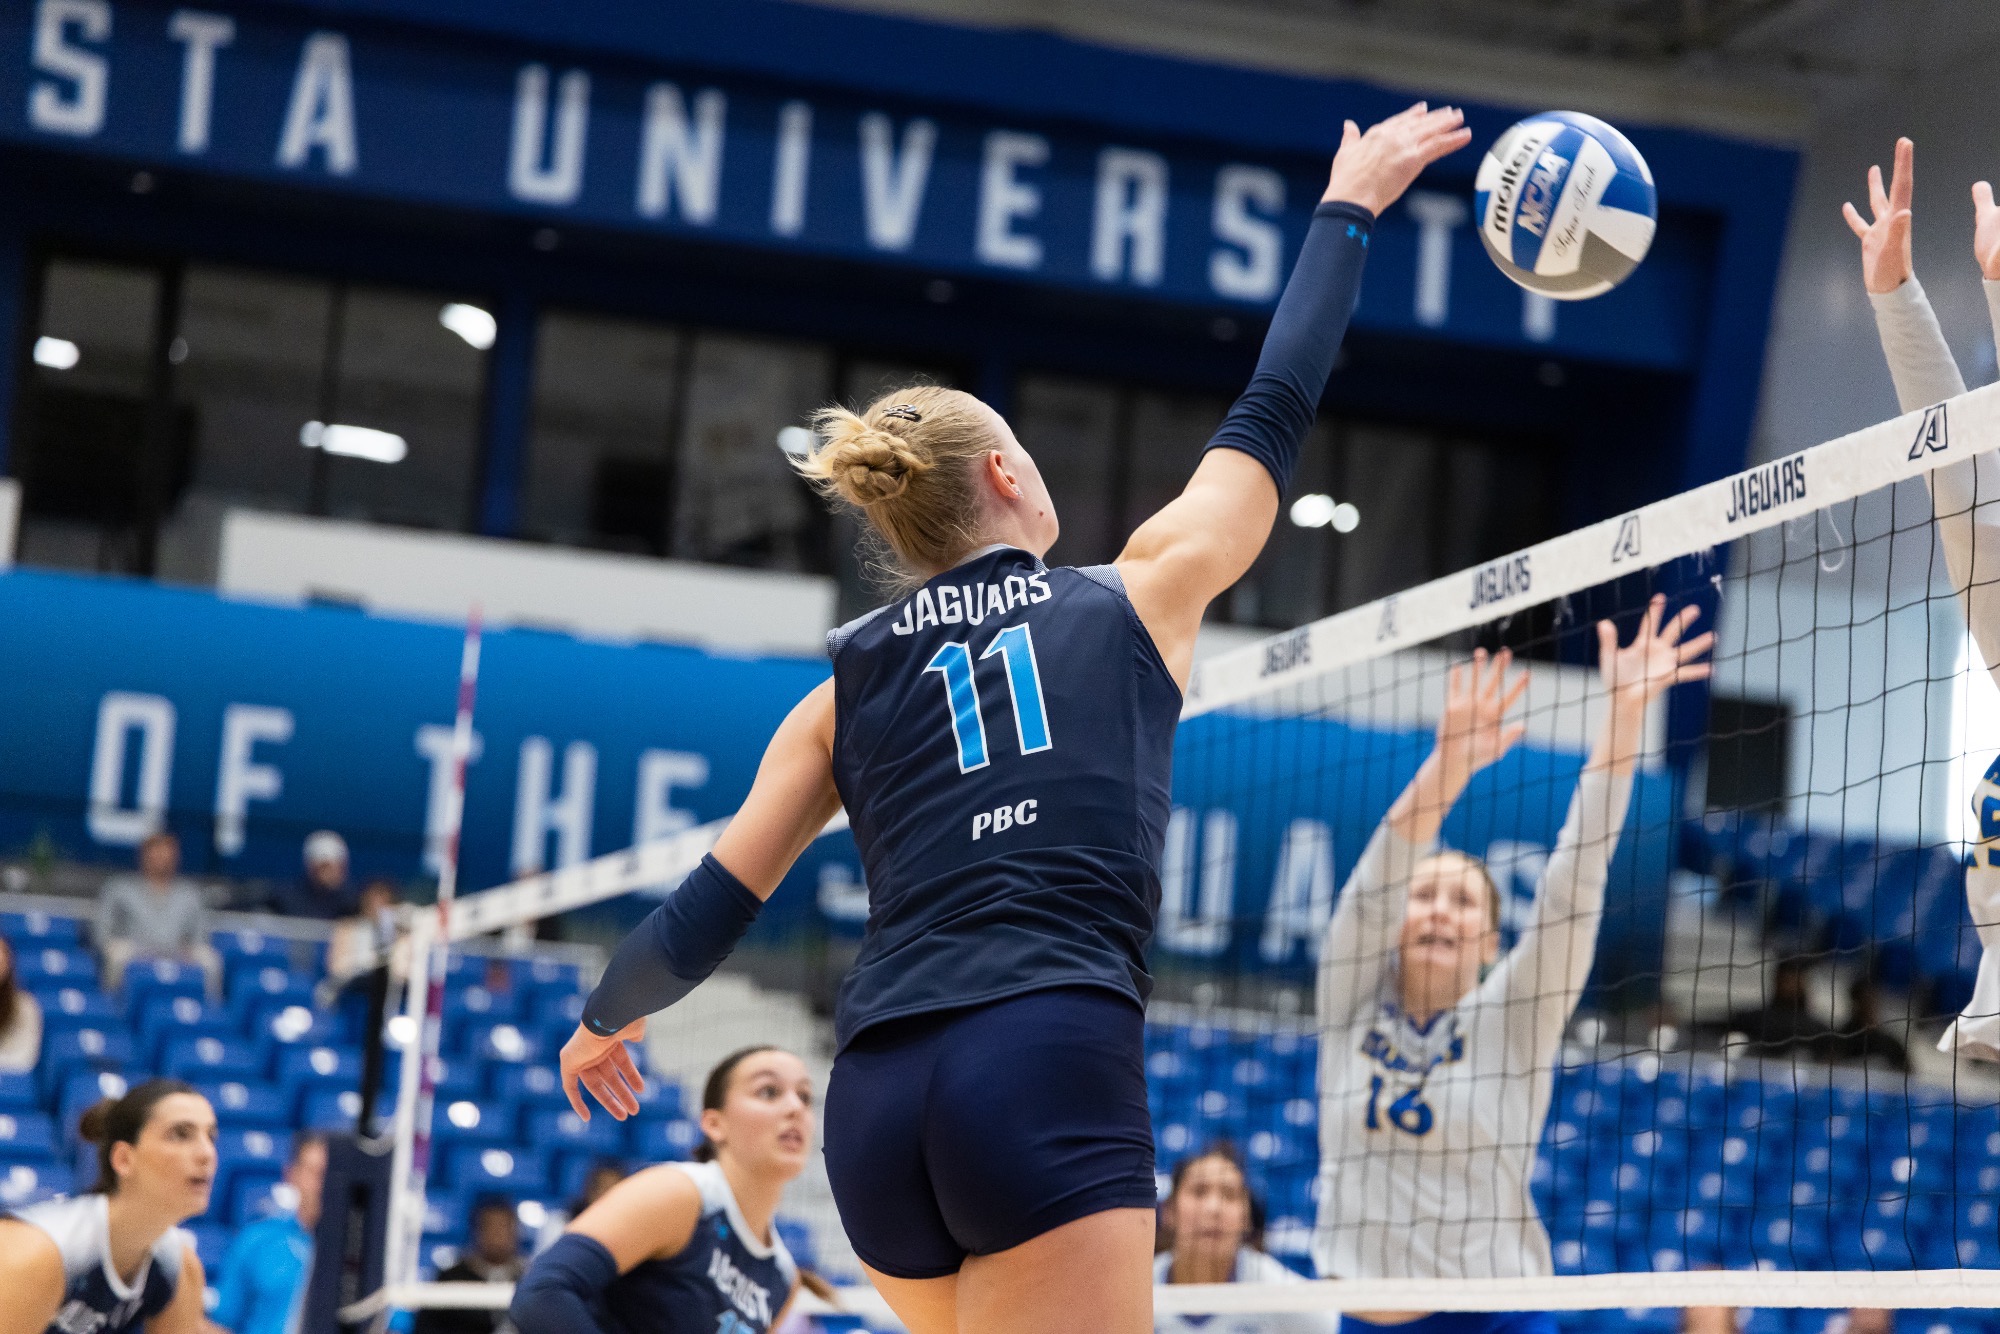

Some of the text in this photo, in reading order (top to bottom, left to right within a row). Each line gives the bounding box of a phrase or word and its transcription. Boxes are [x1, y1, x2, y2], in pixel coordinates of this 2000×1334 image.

[28, 0, 1557, 341] STA UNIVERST
[1492, 137, 1540, 234] molten
[1516, 148, 1571, 237] NCAA
[1726, 455, 1807, 523] JAGUARS
[891, 570, 1053, 636] JAGUARS
[921, 621, 1053, 775] 11
[87, 690, 295, 856] OF
[415, 722, 711, 897] THE
[972, 799, 1038, 841] PBC
[1365, 1073, 1434, 1137] 16
